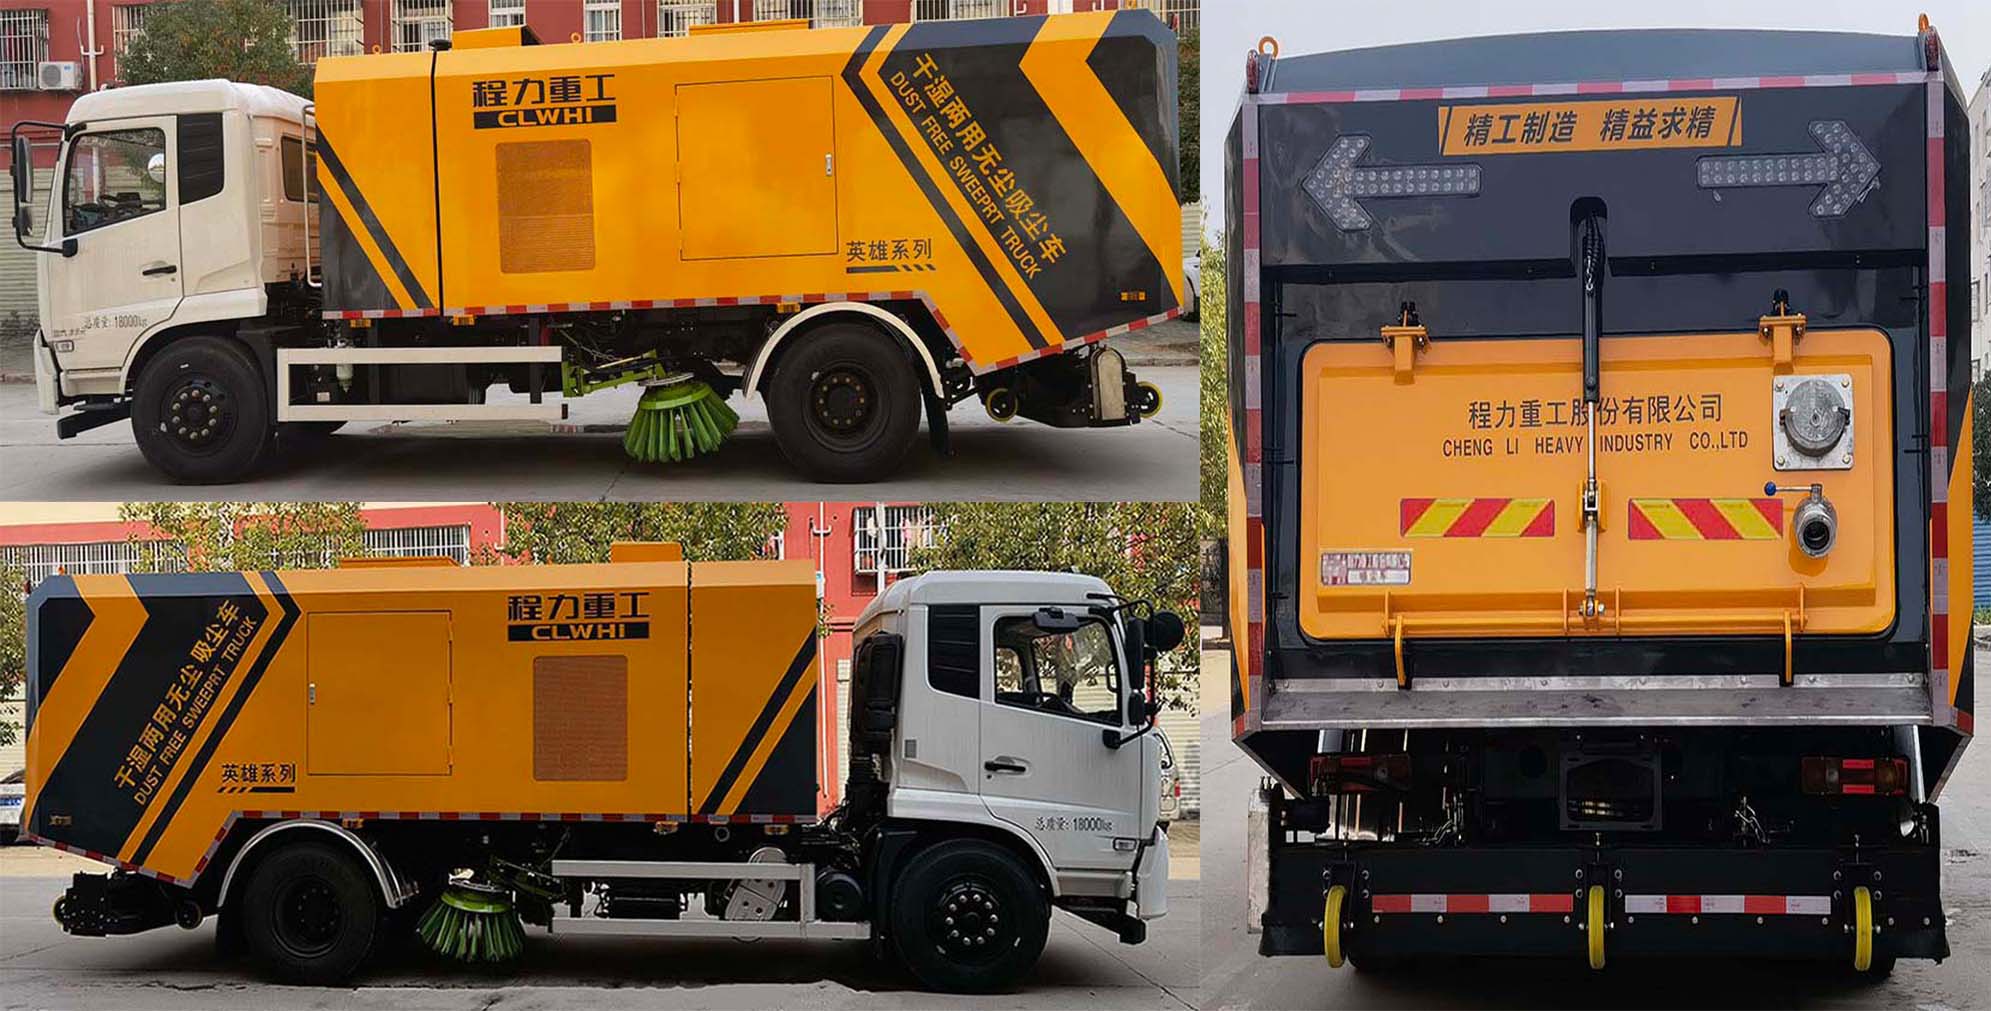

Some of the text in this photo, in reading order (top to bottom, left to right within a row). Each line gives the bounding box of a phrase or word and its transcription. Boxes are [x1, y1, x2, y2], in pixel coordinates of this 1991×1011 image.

[472, 73, 616, 108] 程力重工
[497, 106, 593, 127] CLWHI
[1463, 105, 1717, 147] 精工制造 精益求精
[890, 71, 1043, 280] DUST FREE SWEEPRT TRUCK
[912, 52, 1067, 264] 干湿两用无尘吸尘车
[846, 238, 932, 262] 英雄系列
[1468, 393, 1723, 430] 程力重工股份有限公司
[1442, 431, 1749, 457] CHENG LI HEAVY INDUSTRY CO.,LTD
[507, 591, 650, 621] 程力重工
[531, 623, 626, 640] CLWHI
[113, 599, 241, 789] 干湿两用无尘吸尘车
[133, 615, 258, 806] DUST FREE SWEEPRT TRUCK
[221, 763, 296, 783] 英雄系列
